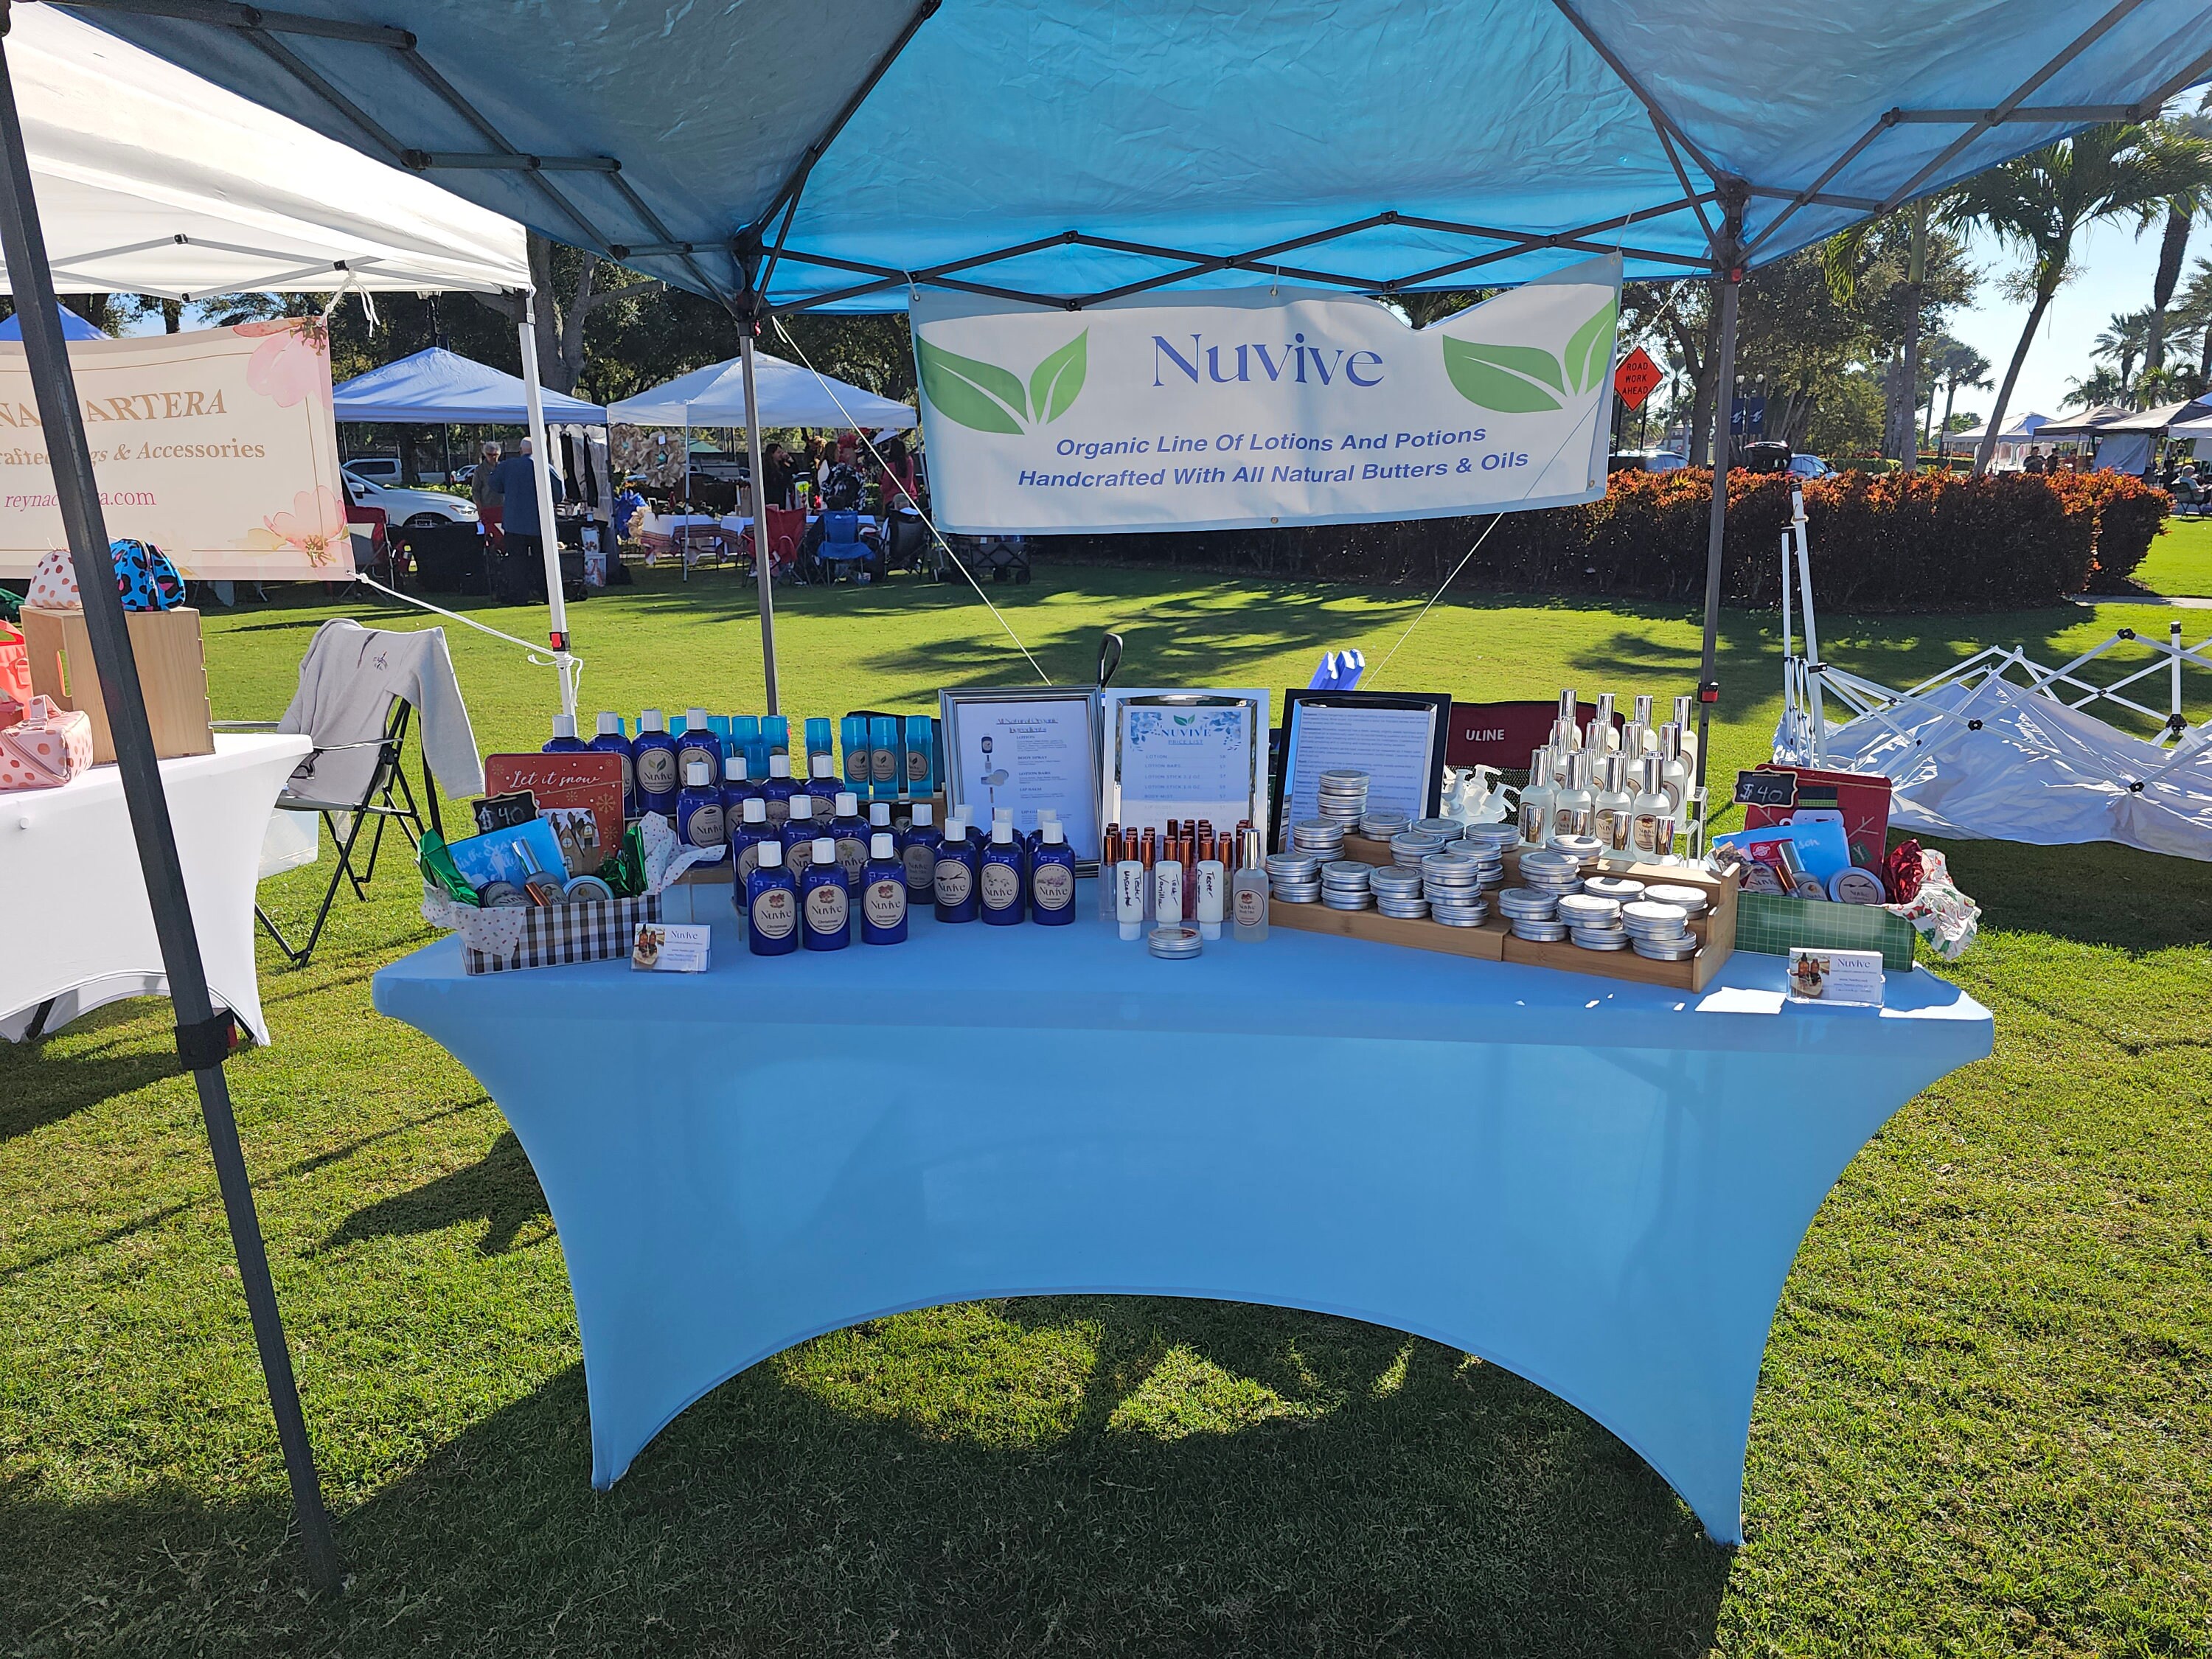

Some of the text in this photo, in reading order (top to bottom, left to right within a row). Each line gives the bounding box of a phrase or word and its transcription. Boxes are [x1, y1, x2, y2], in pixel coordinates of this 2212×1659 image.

[1152, 333, 1385, 388] Nuvive
[1626, 361, 1649, 372] ROAD
[1625, 374, 1648, 384] WORK
[1621, 385, 1649, 395] AHEAD
[81, 389, 227, 422] ARTERA
[1056, 426, 1487, 459] Organic Line Of Lotions And Potions
[114, 443, 131, 461] &
[136, 438, 265, 459] Accessories
[1018, 449, 1529, 487] Handcrafted With All Natural Butters & Oils
[1161, 728, 1211, 737] NUVIVE
[1465, 728, 1505, 742] ULINE
[509, 770, 601, 789] Let it snow
[644, 771, 672, 782] Nuvive
[1039, 886, 1068, 896] Nuvive
[812, 905, 843, 915] Nuvive
[871, 900, 901, 910] Nuvive
[761, 910, 793, 920] Nuvive
[671, 930, 699, 940] Nuvive
[1837, 958, 1871, 969] Nuvive
